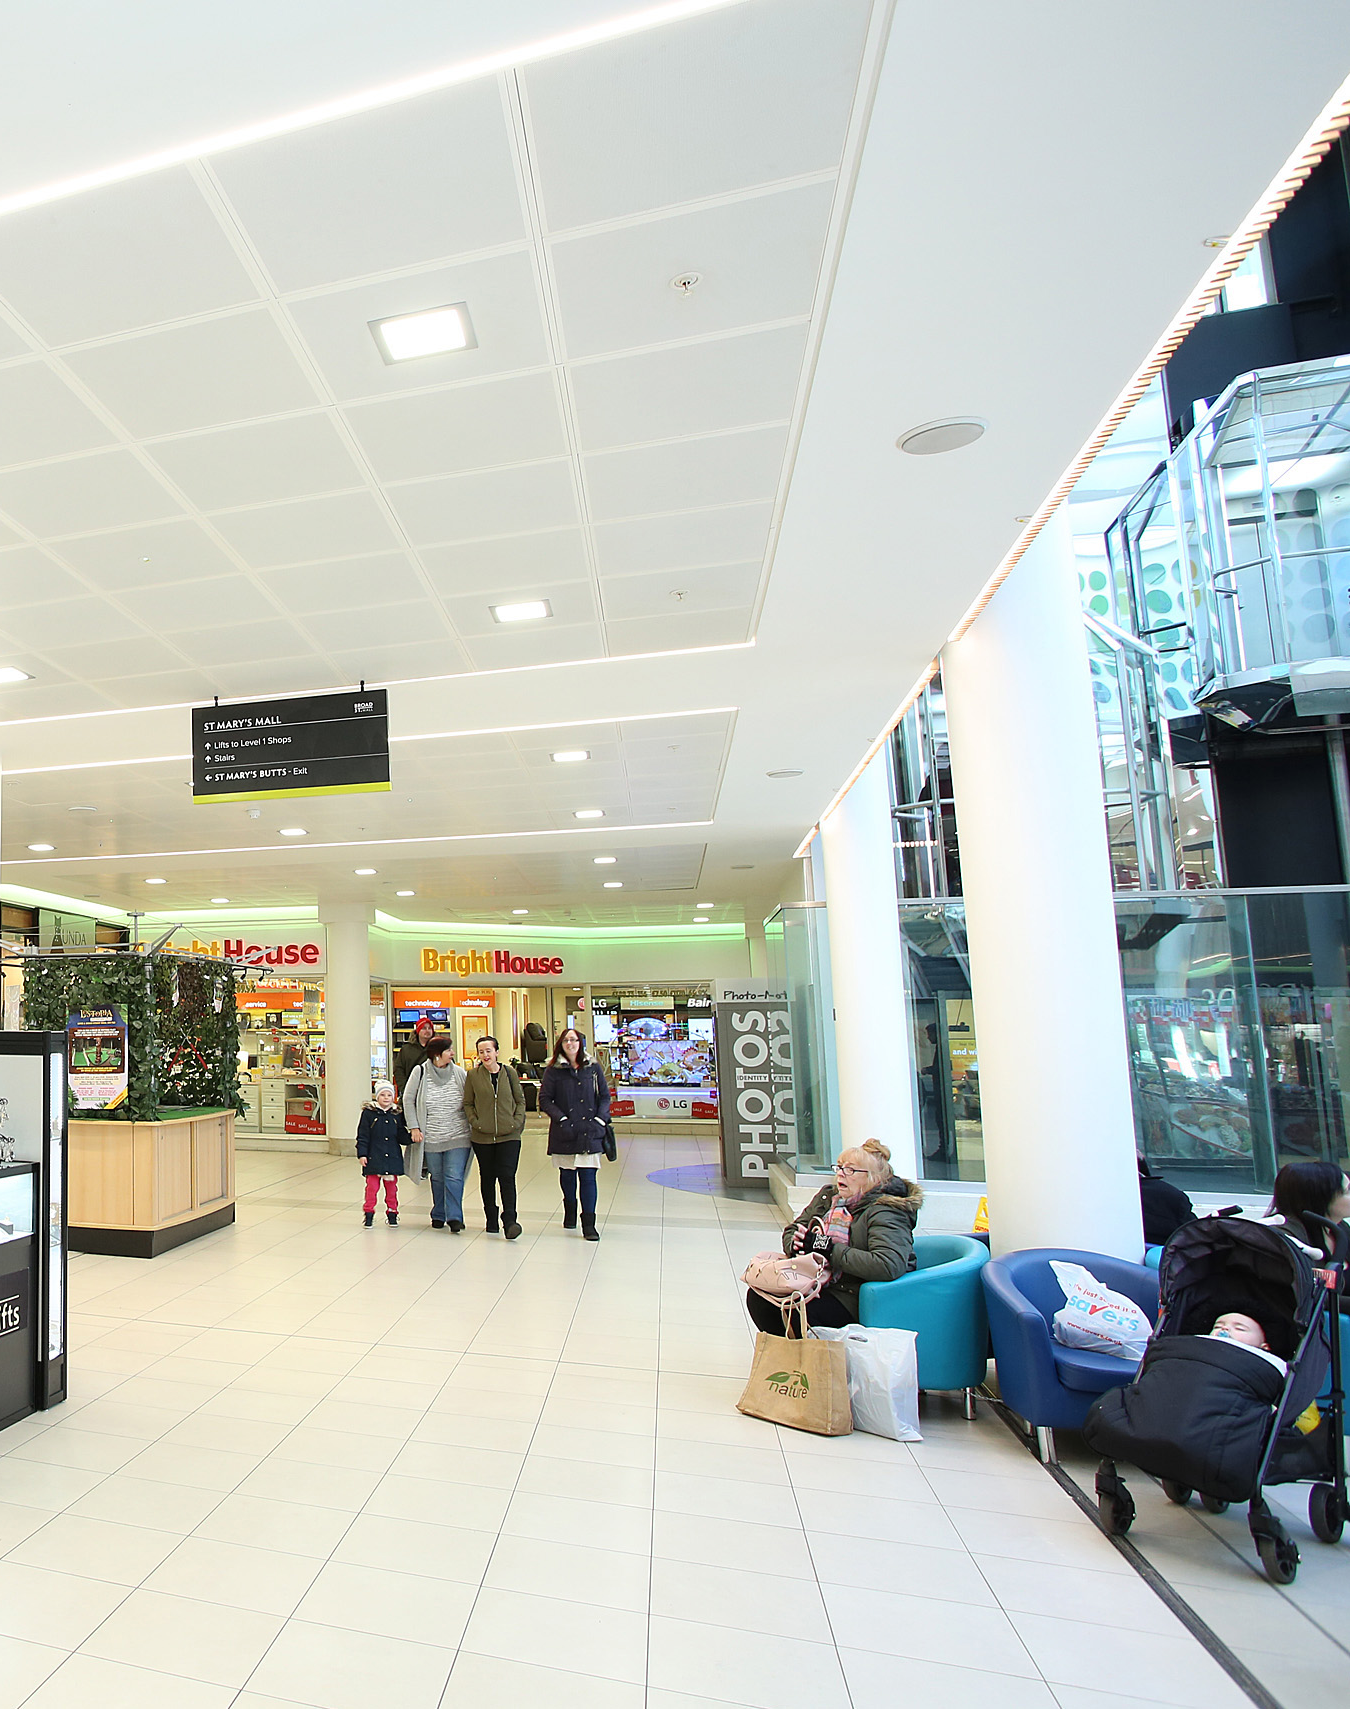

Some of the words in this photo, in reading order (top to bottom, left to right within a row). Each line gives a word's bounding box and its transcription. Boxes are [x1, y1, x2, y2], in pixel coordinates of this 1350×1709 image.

[203, 721, 216, 731] ST
[217, 718, 253, 730] MARY'S
[254, 715, 282, 726] MALL
[214, 740, 230, 750] Lifts
[231, 739, 239, 748] to
[240, 737, 261, 748] Level
[262, 737, 266, 746] 1
[267, 735, 292, 747] Shops
[214, 753, 236, 763] Stairs
[214, 773, 226, 782] ST
[226, 769, 258, 781] MARY'S
[259, 768, 288, 778] BUTTS
[293, 767, 308, 776] Exit
[421, 947, 565, 978] BrightHouse
[404, 999, 442, 1008] technology
[459, 998, 490, 1008] technology
[592, 999, 607, 1008] LG
[687, 998, 712, 1008] Bair
[952, 1047, 967, 1056] and
[731, 1010, 774, 1178] PHOTOS
[673, 1099, 688, 1109] LG
[1082, 1288, 1098, 1298] just
[1067, 1295, 1140, 1332] savers
[1066, 1321, 1123, 1346] www.savers.co.uk
[767, 1380, 809, 1399] nature
